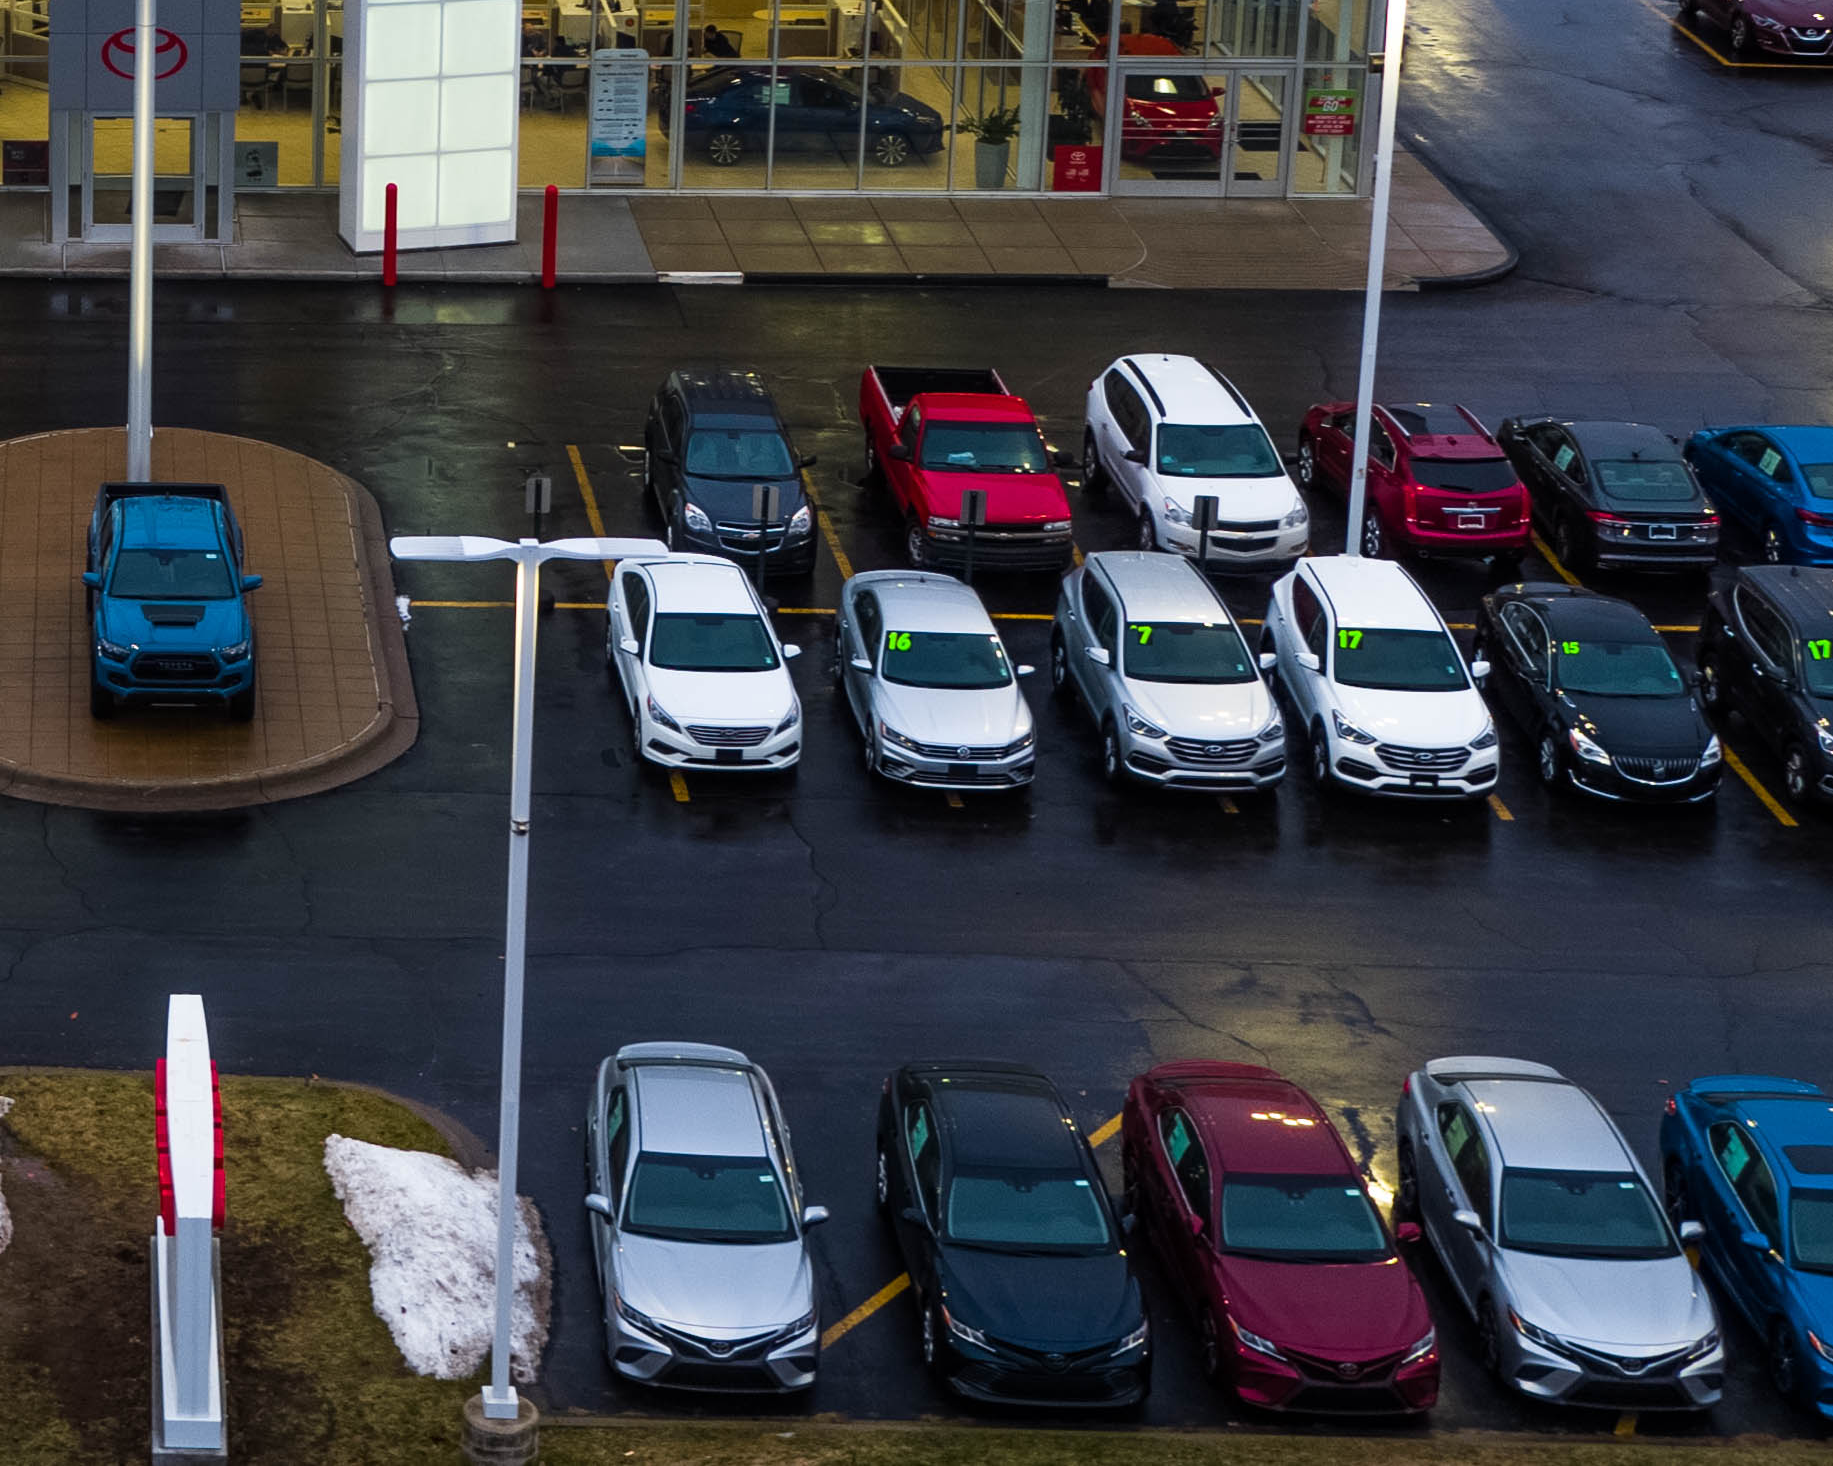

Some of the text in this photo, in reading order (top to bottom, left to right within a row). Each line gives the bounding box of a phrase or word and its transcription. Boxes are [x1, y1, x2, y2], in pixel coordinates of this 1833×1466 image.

[888, 631, 912, 651] 16
[1129, 624, 1153, 645] 7
[1338, 629, 1363, 649] 17
[1562, 641, 1580, 654] 15
[1807, 639, 1831, 660] 17
